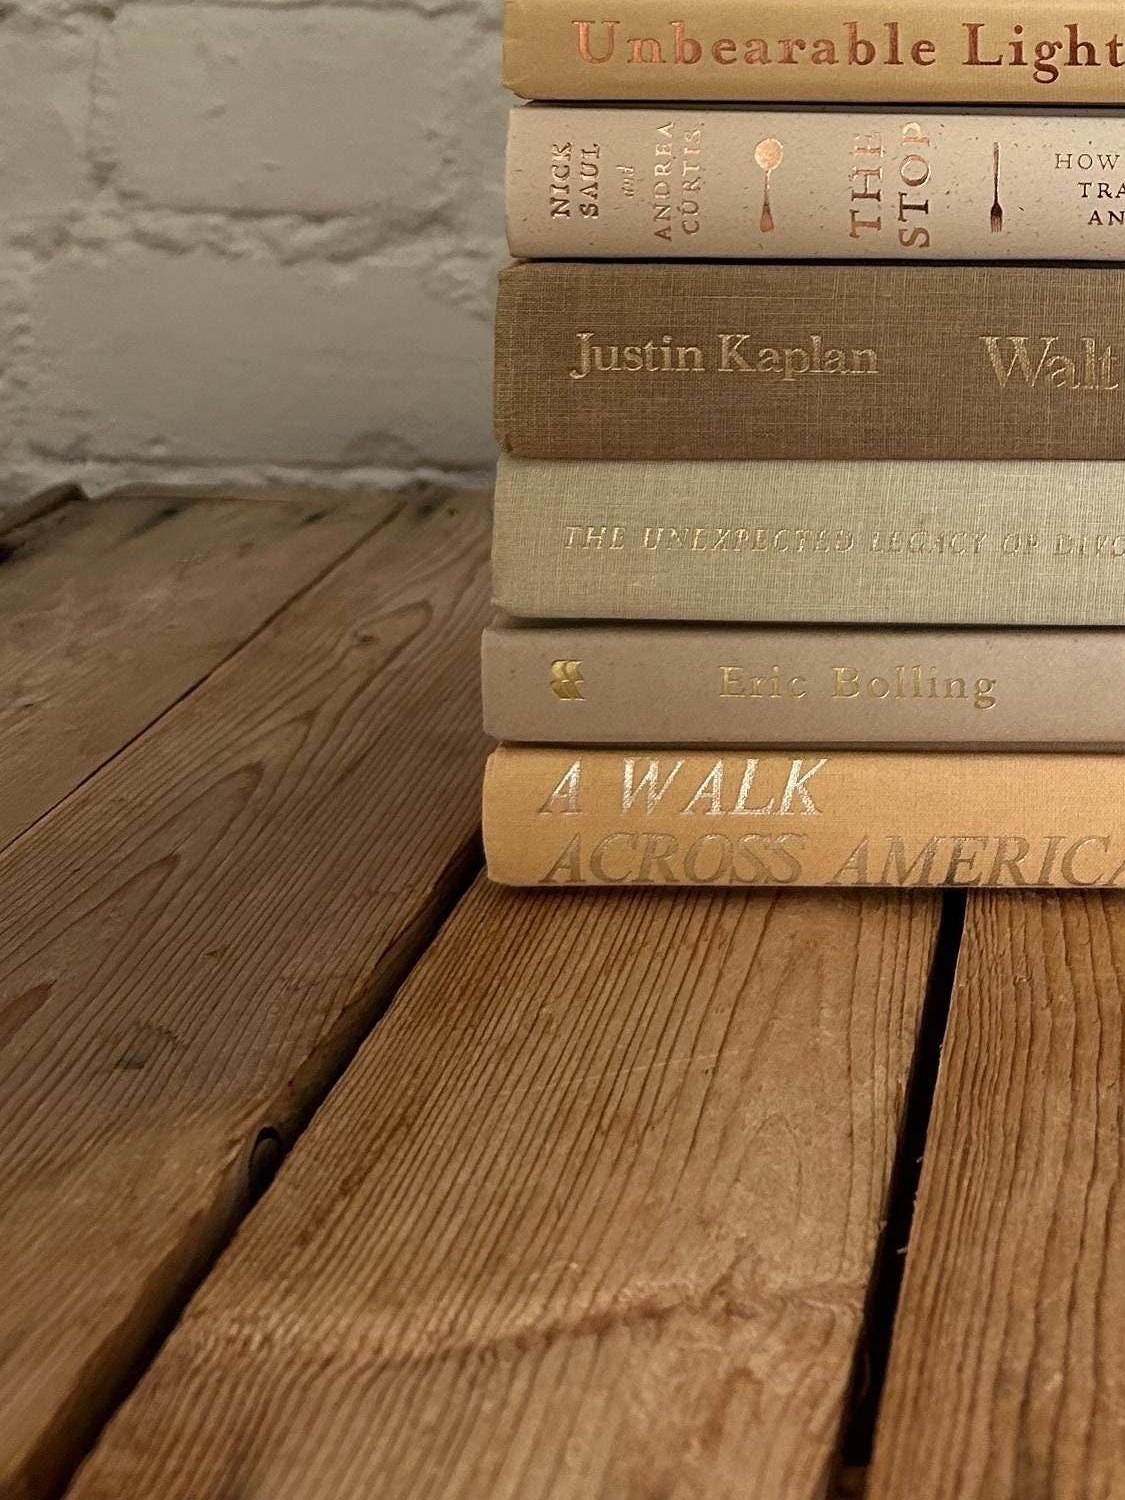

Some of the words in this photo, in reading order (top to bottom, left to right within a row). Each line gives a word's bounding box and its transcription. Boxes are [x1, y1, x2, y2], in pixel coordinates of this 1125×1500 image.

[572, 20, 937, 66] Unbearable
[551, 142, 571, 219] NICK
[579, 143, 600, 219] SAUL
[654, 122, 673, 242] ANDREA
[682, 129, 701, 235] CURTIS
[849, 130, 883, 237] THE
[899, 122, 931, 247] STOP
[1055, 153, 1120, 171] HOW
[570, 332, 705, 380] Justin
[716, 333, 880, 383] Kaplan
[979, 335, 1118, 390] Walt
[564, 525, 627, 550] THE
[642, 527, 855, 553] UNEXPECTED
[719, 665, 807, 699] Eric
[831, 666, 998, 711] Bolling
[538, 759, 583, 815] A
[618, 757, 829, 815] WALK
[538, 832, 808, 885] ACROSS
